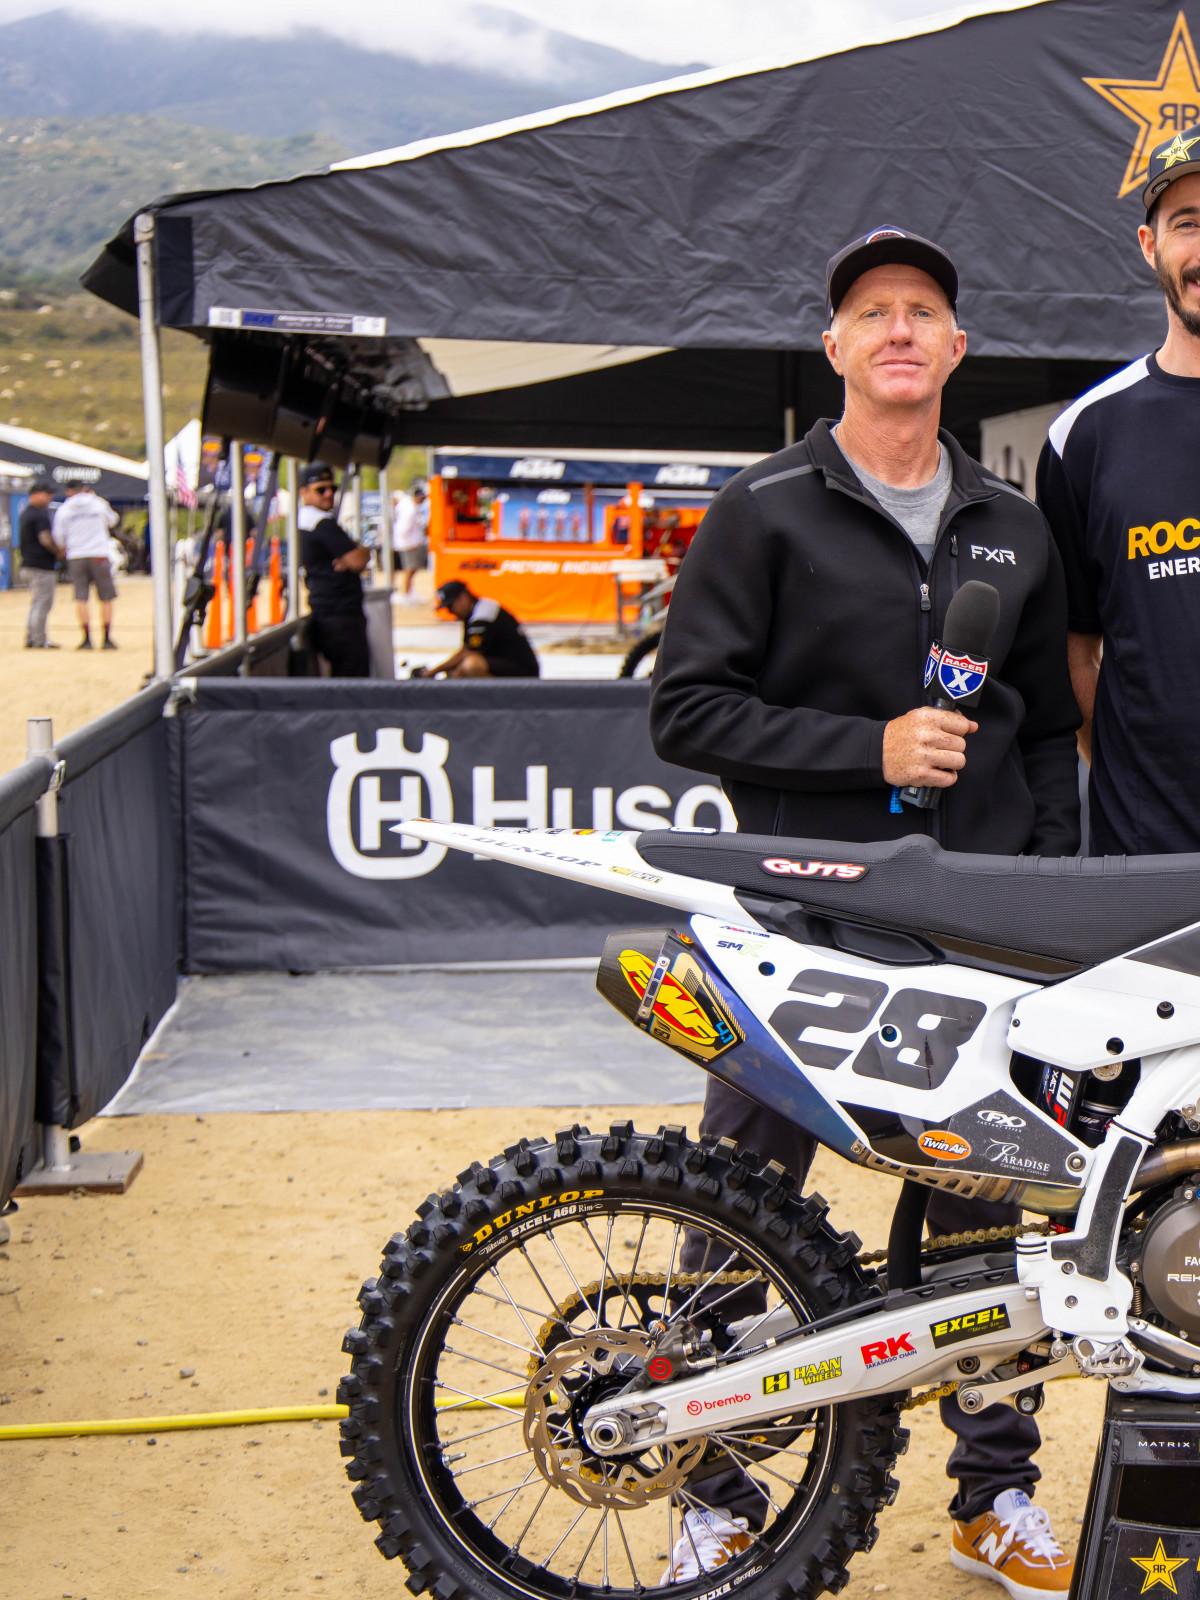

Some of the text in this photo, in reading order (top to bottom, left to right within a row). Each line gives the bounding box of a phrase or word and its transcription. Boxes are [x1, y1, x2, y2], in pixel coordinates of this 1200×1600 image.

[970, 544, 1016, 565] FXR
[945, 658, 983, 673] RACER
[947, 668, 973, 691] X
[472, 836, 602, 867] DUNLOP
[763, 858, 865, 879] GUTS
[767, 968, 988, 1091] 28
[922, 1136, 967, 1155] Twin Air
[985, 1138, 1050, 1172] PARADISE
[473, 1189, 604, 1245] DUNLOP
[509, 1214, 552, 1238] EXCEL
[553, 1204, 577, 1219] A60
[578, 1203, 594, 1213] Rim
[933, 1307, 1006, 1337] EXCEL
[860, 1331, 916, 1365] RK
[866, 1349, 918, 1369] TAKASAGO CHAIN
[794, 1355, 842, 1380] HAAN
[803, 1368, 842, 1386] WHEELS
[703, 1393, 751, 1410] brembo
